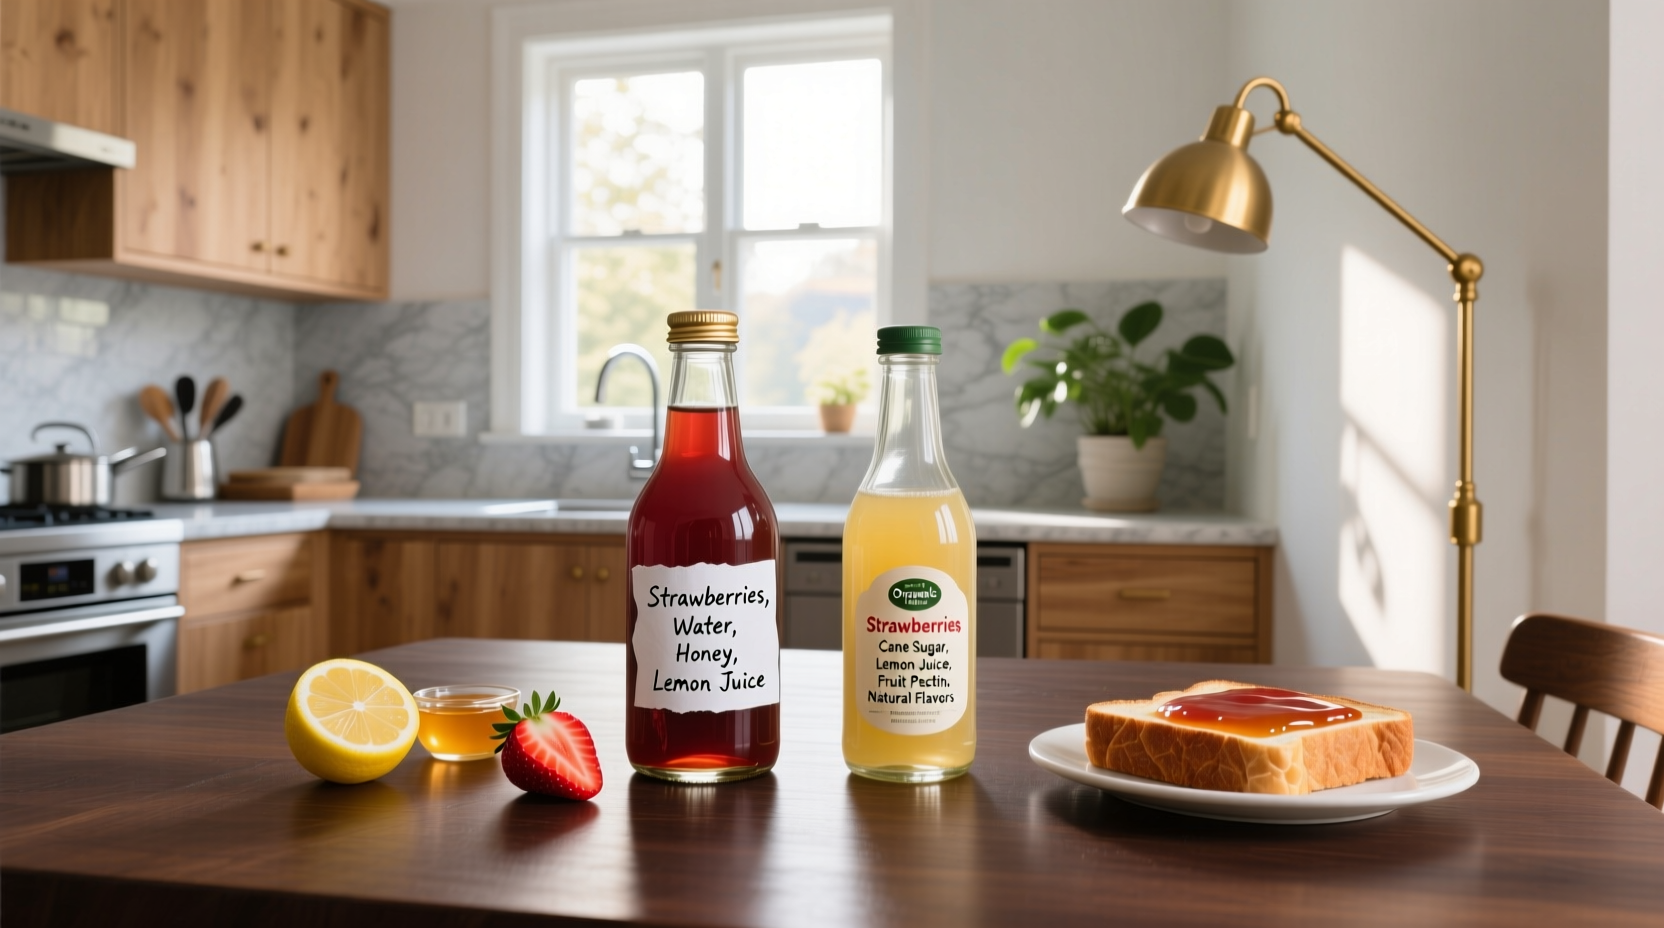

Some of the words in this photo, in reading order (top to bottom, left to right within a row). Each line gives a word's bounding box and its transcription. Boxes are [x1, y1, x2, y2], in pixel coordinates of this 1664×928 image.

[647, 585, 769, 608] Strawberries,
[673, 615, 737, 638] Water,
[866, 615, 961, 633] Strawberries
[676, 643, 738, 668] Honey,
[878, 639, 910, 653] Cane
[912, 640, 949, 657] Sugar,
[876, 657, 915, 671] Lemon
[919, 658, 952, 671] Juice,
[653, 669, 711, 692] Lemon
[719, 671, 766, 692] Juice
[878, 674, 907, 688] Fruit
[867, 690, 912, 704] Natural
